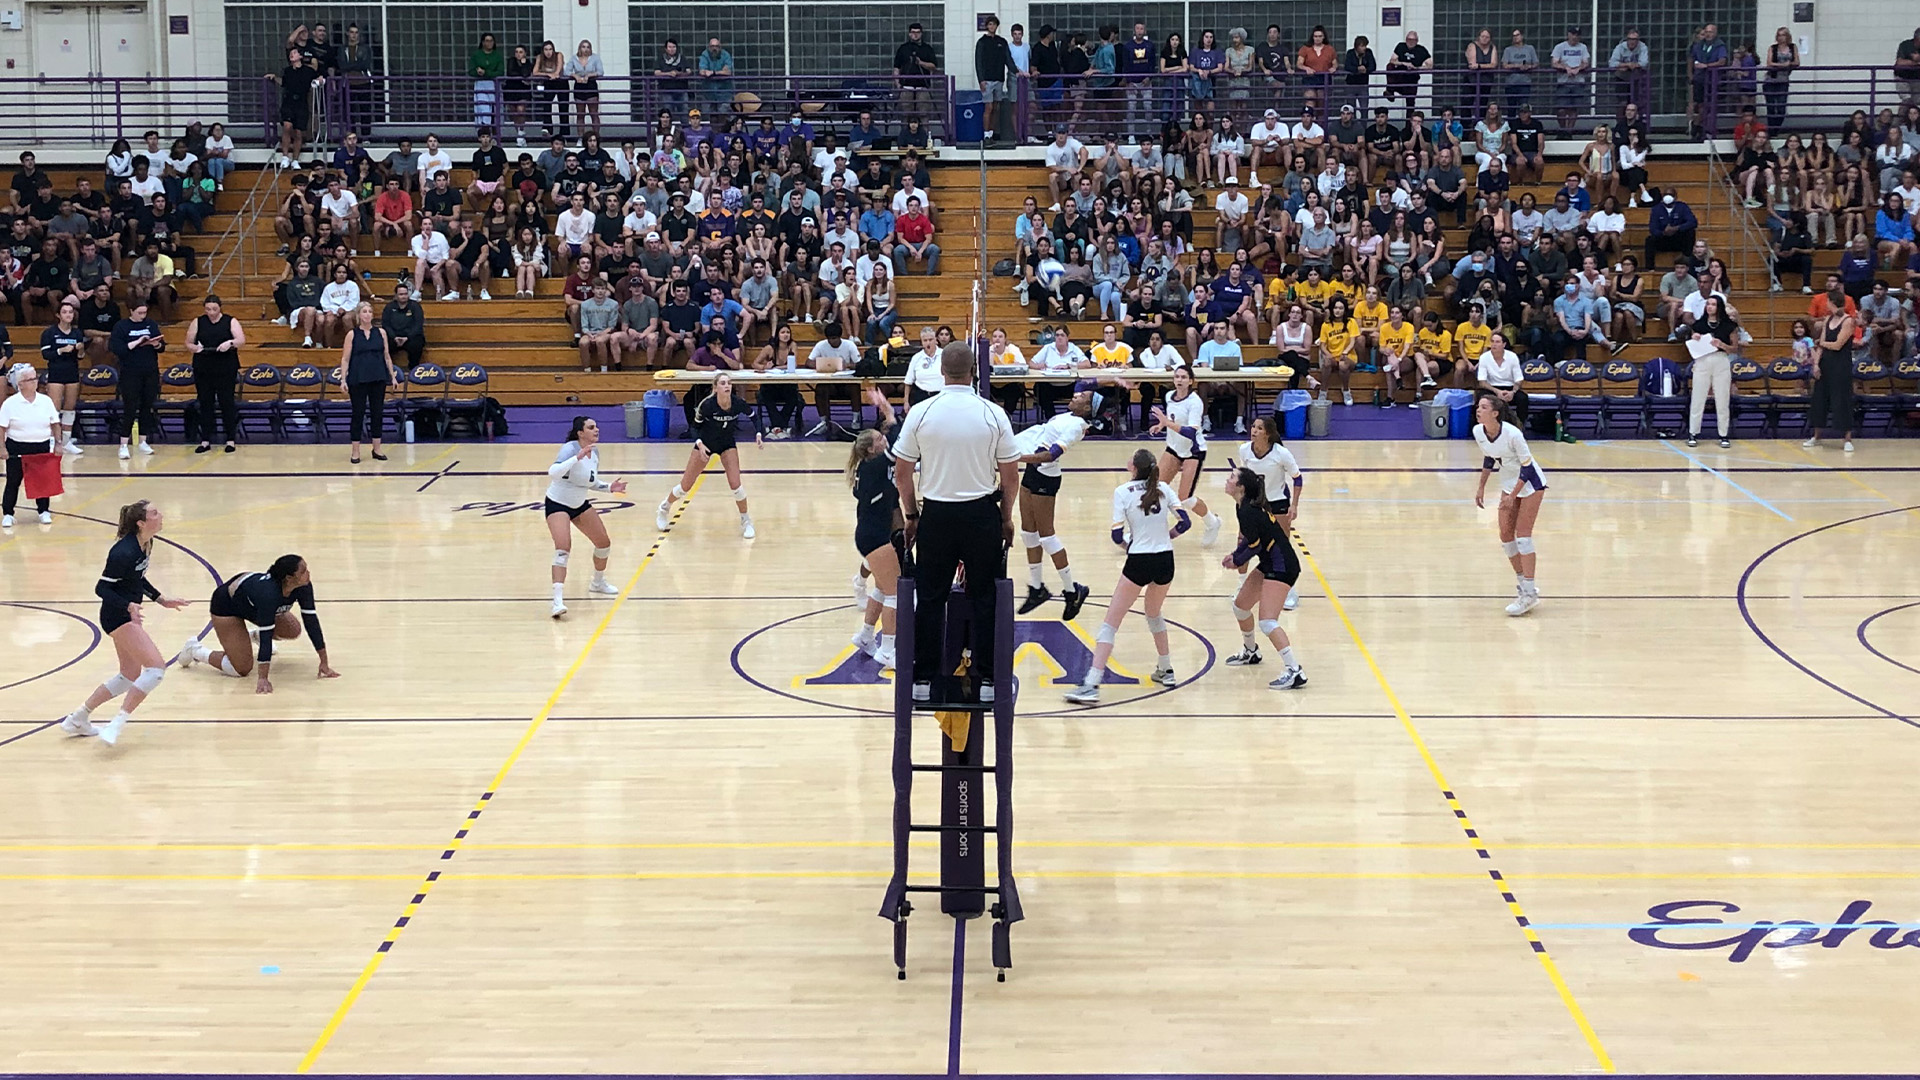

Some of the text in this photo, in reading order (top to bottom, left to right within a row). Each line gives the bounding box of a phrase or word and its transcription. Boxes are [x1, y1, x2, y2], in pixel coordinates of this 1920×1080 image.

[249, 368, 274, 381] Ephs
[290, 367, 316, 380] Ephs
[414, 366, 439, 380] Ephs
[455, 366, 480, 380] Ephs
[1524, 362, 1550, 376] Ephs
[1566, 362, 1591, 376] Ephs
[1607, 362, 1632, 376] Ephs
[957, 780, 969, 857] sports imorts
